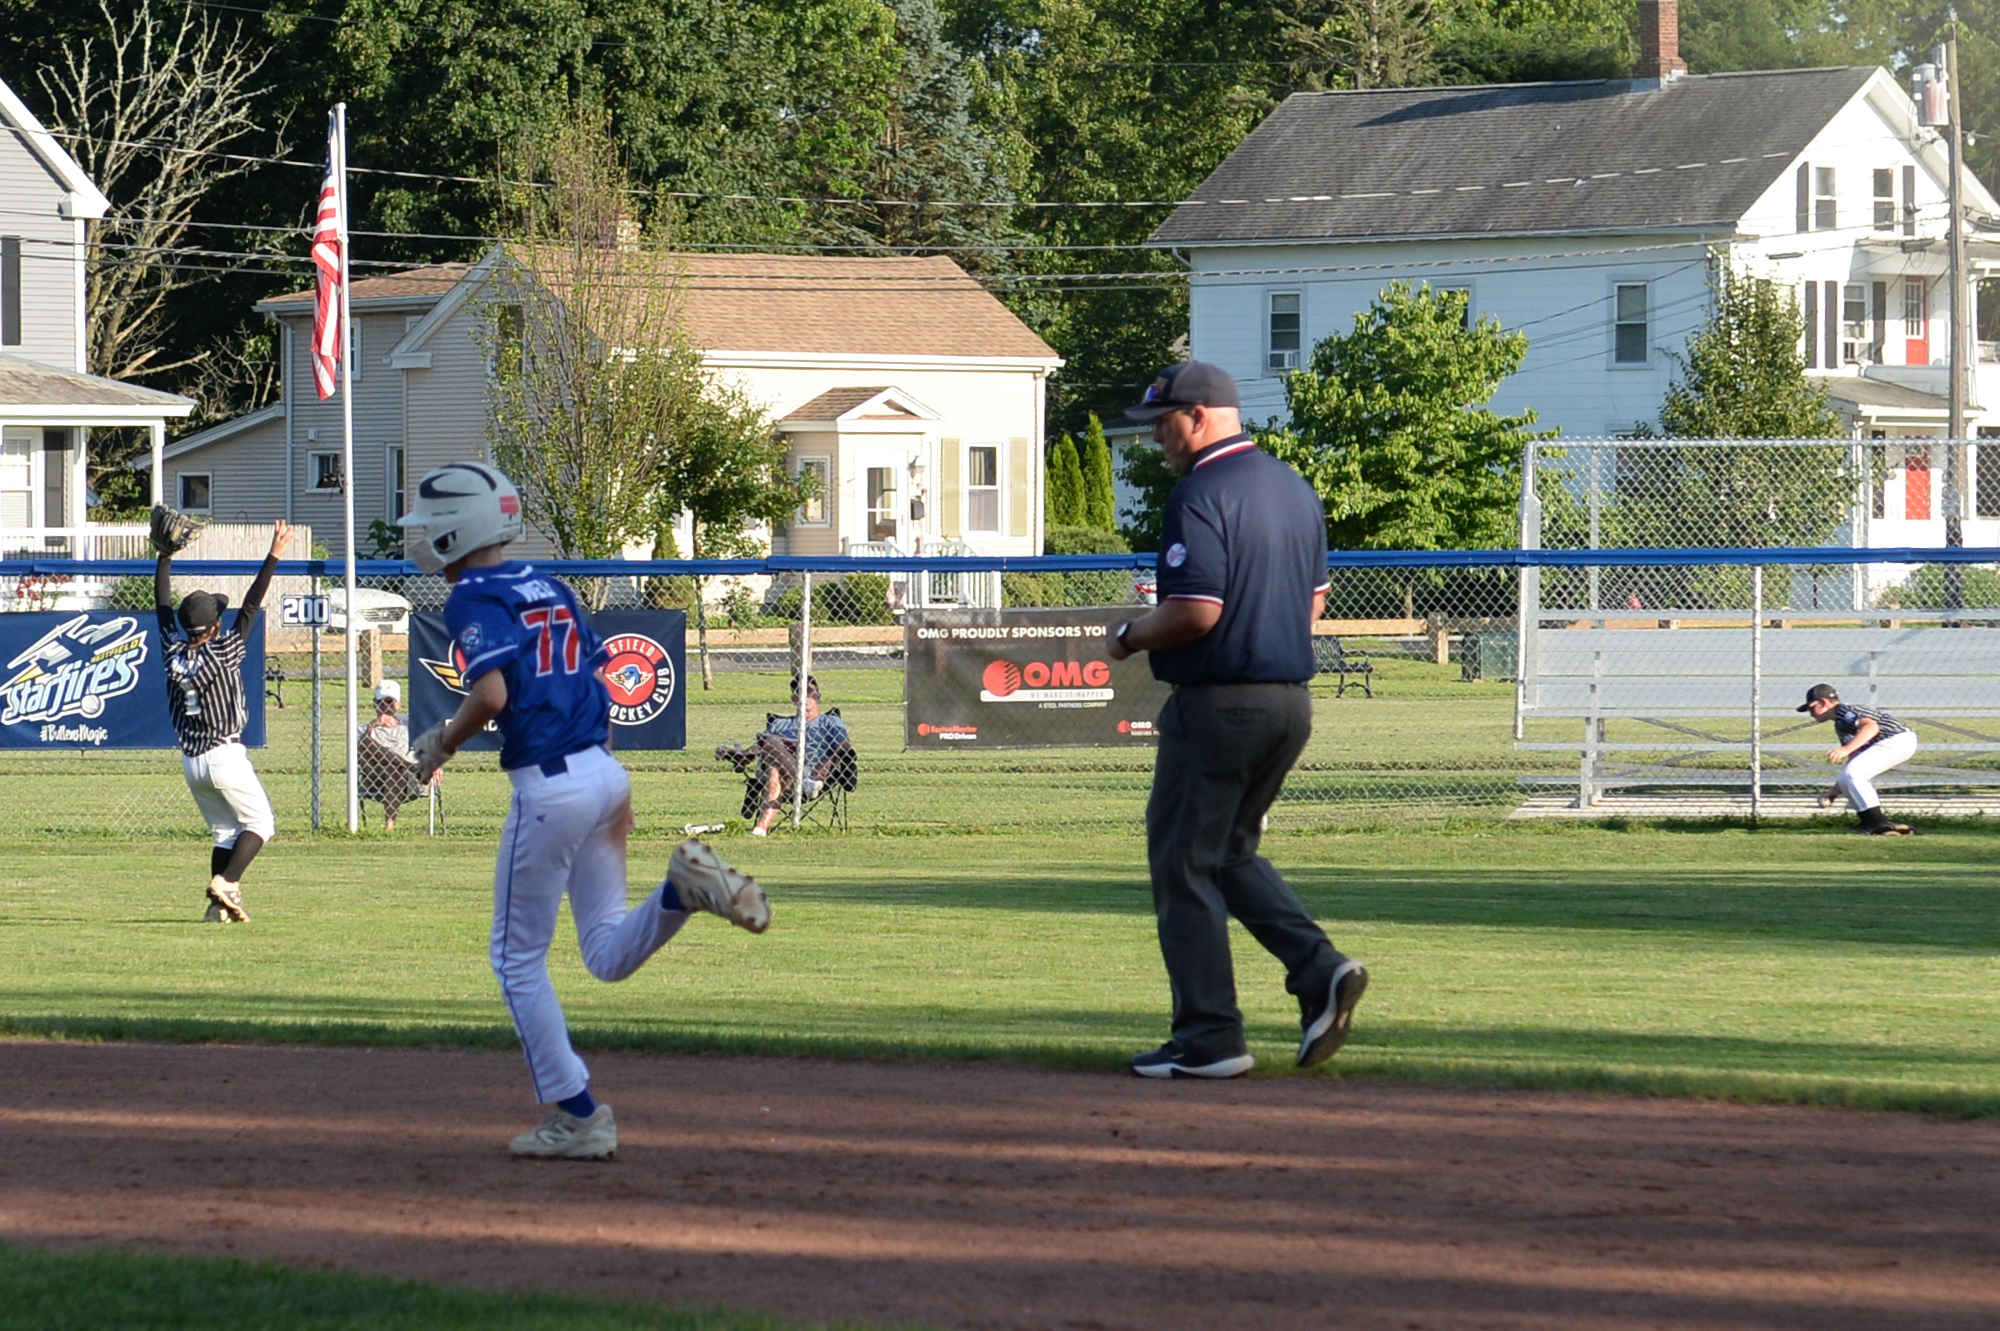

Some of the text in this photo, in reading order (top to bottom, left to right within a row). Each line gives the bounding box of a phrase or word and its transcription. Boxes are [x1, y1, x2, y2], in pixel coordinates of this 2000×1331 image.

[283, 598, 329, 624] 200
[520, 604, 580, 678] 77
[916, 627, 950, 639] OMG
[951, 627, 1010, 639] PROUDLY
[1011, 625, 1081, 638] SPONSORS
[1024, 660, 1111, 688] OMG
[608, 667, 671, 721] OCKEY CLUB
